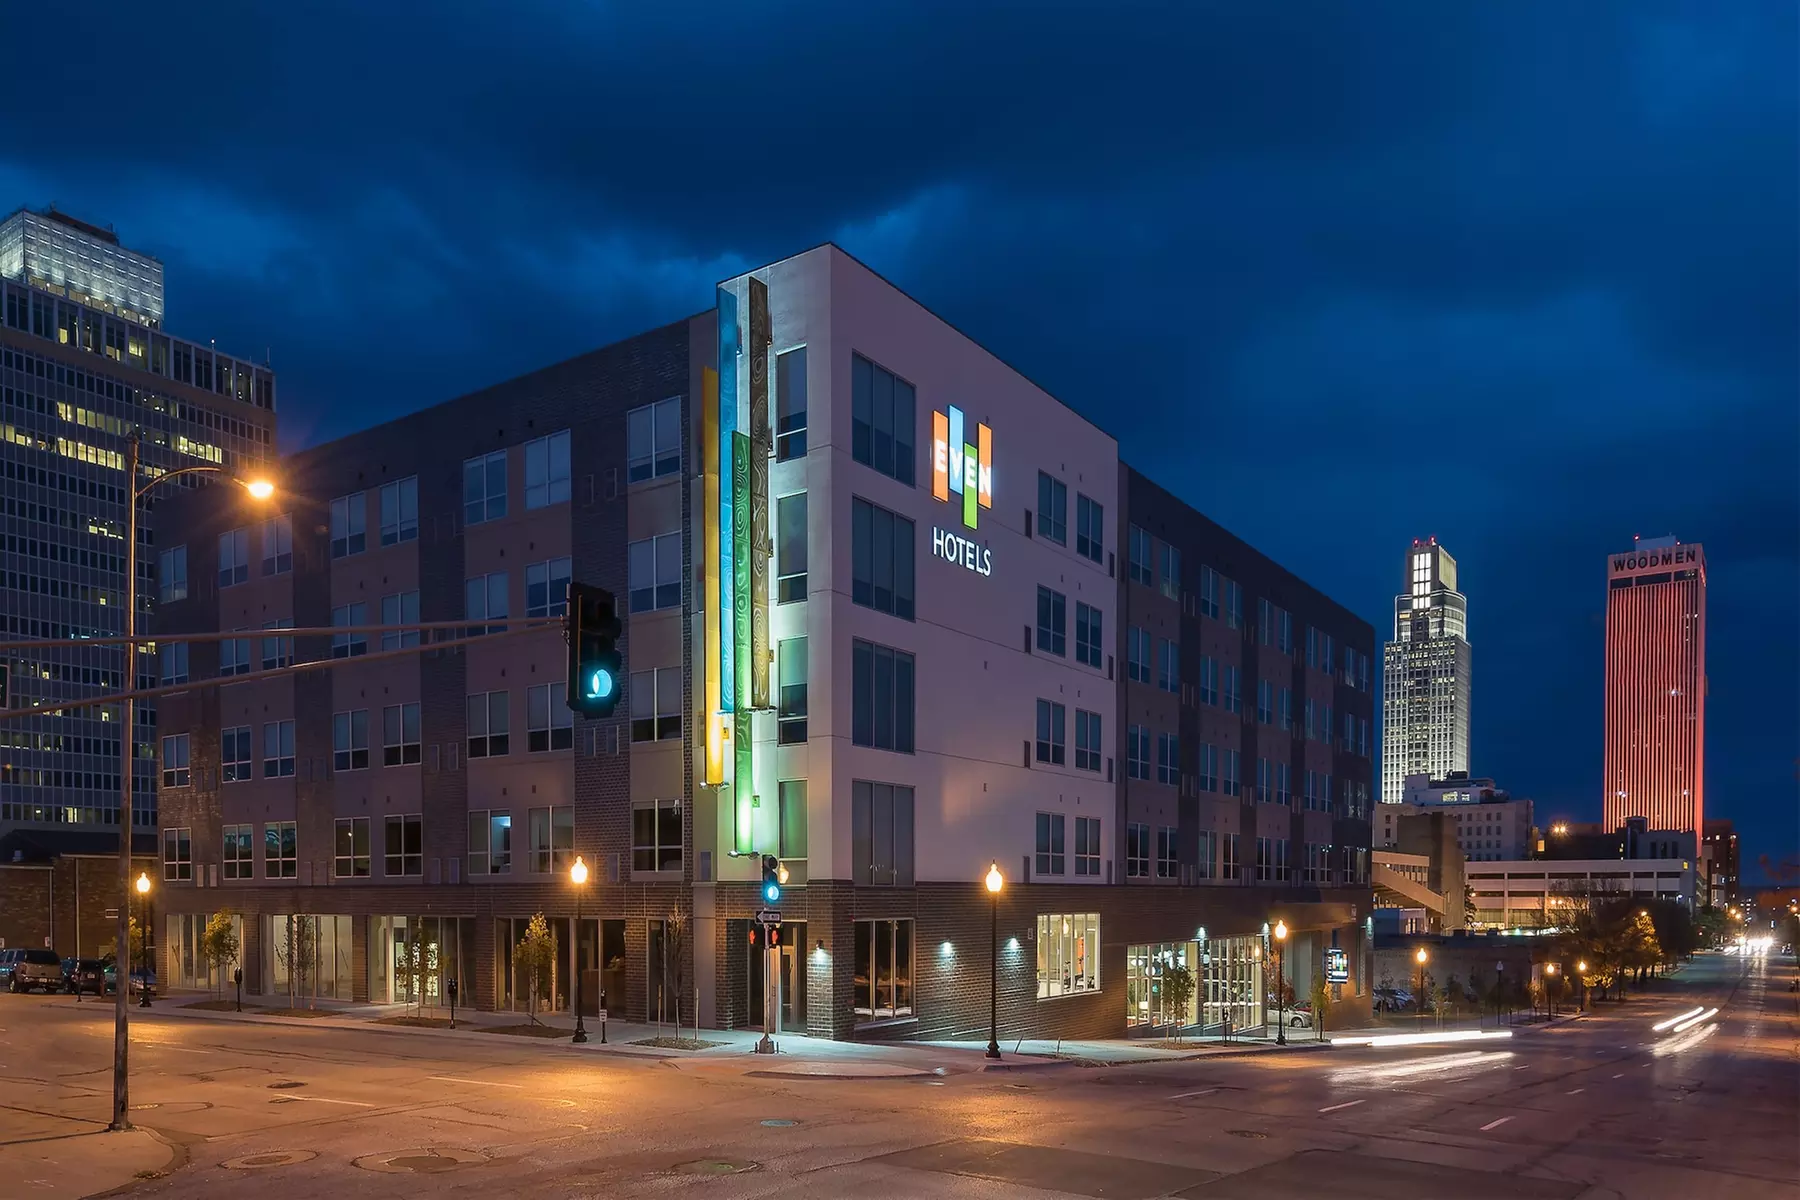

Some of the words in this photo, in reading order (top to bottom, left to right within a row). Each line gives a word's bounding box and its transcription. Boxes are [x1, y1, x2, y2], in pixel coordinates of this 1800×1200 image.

[935, 440, 992, 497] EVEN
[933, 526, 991, 577] HOTELS
[1613, 550, 1696, 572] WOODMEN
